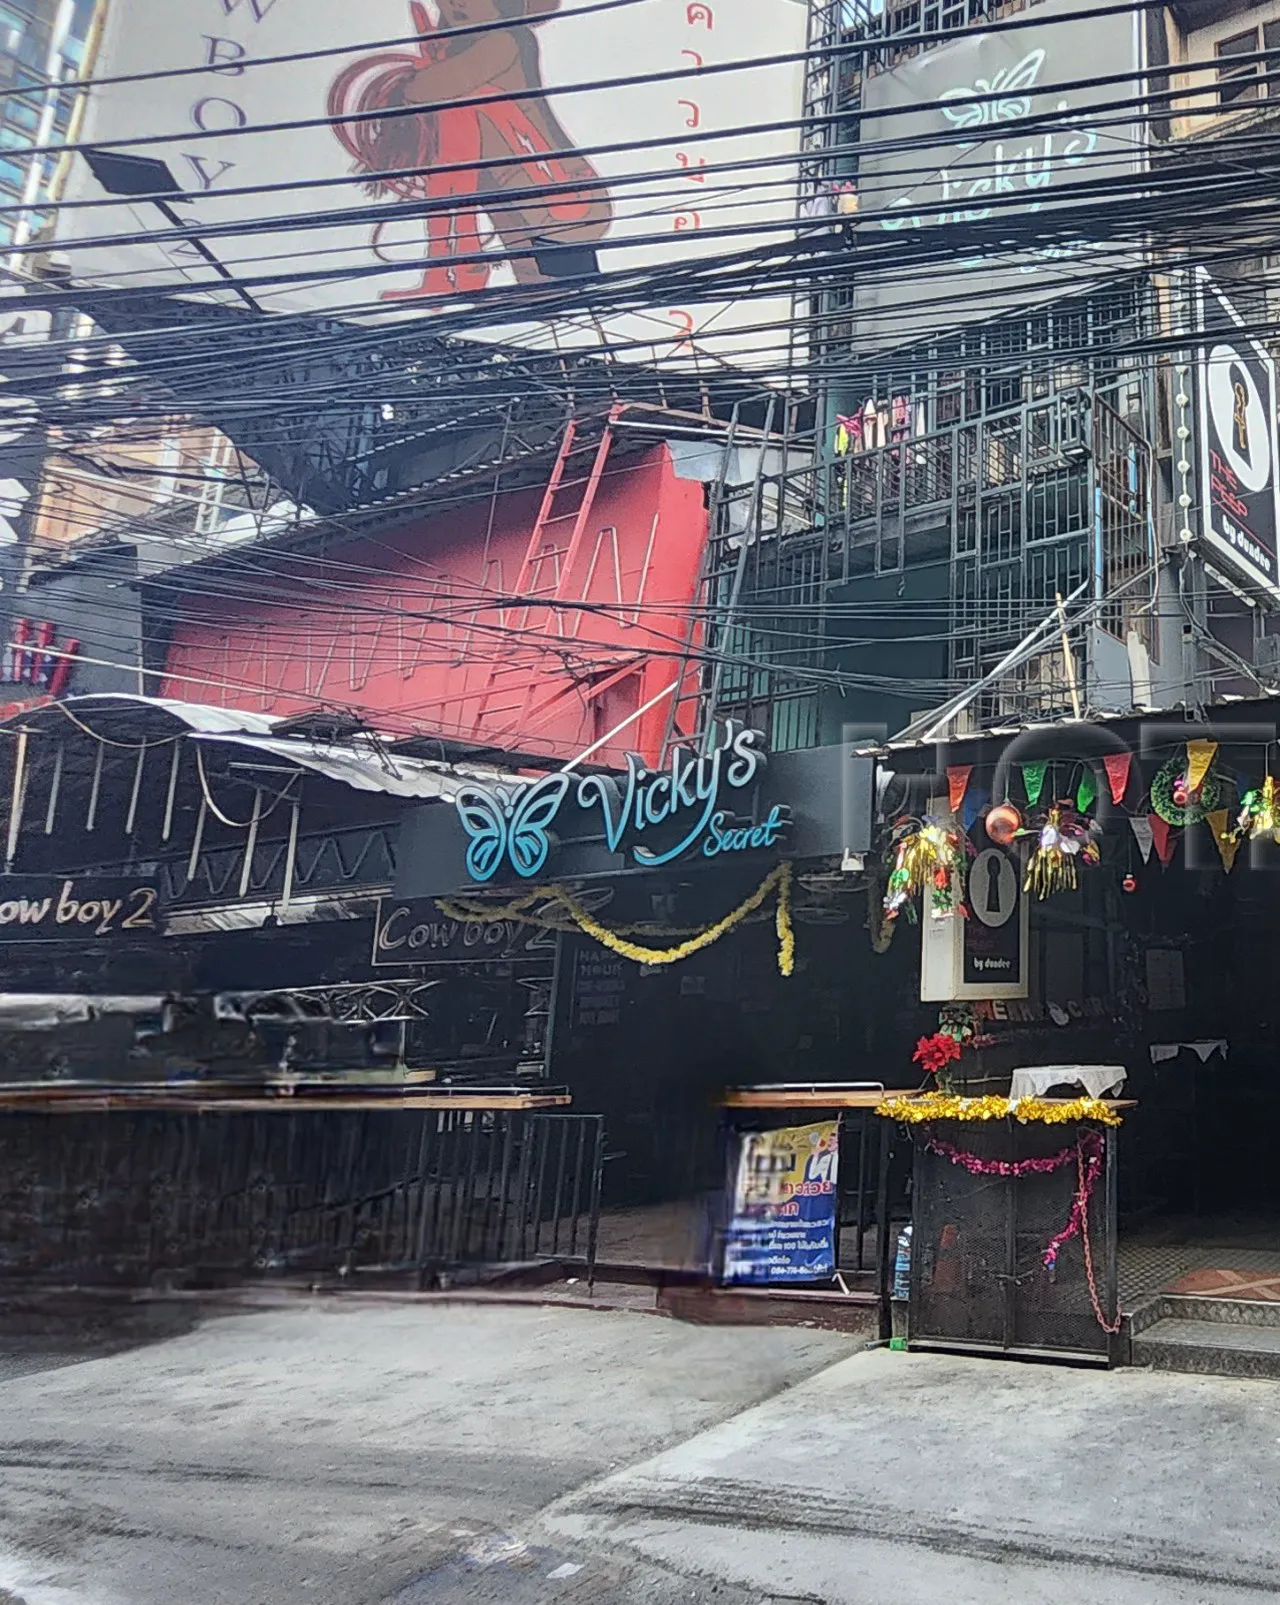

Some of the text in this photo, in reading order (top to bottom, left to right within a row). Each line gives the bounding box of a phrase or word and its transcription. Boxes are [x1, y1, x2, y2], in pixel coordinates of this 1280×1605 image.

[1221, 513, 1237, 546] by
[577, 717, 762, 866] Vicky's
[702, 803, 785, 857] Secret
[0, 897, 53, 925] ow
[121, 886, 157, 929] 2
[973, 956, 1012, 971] by dundee
